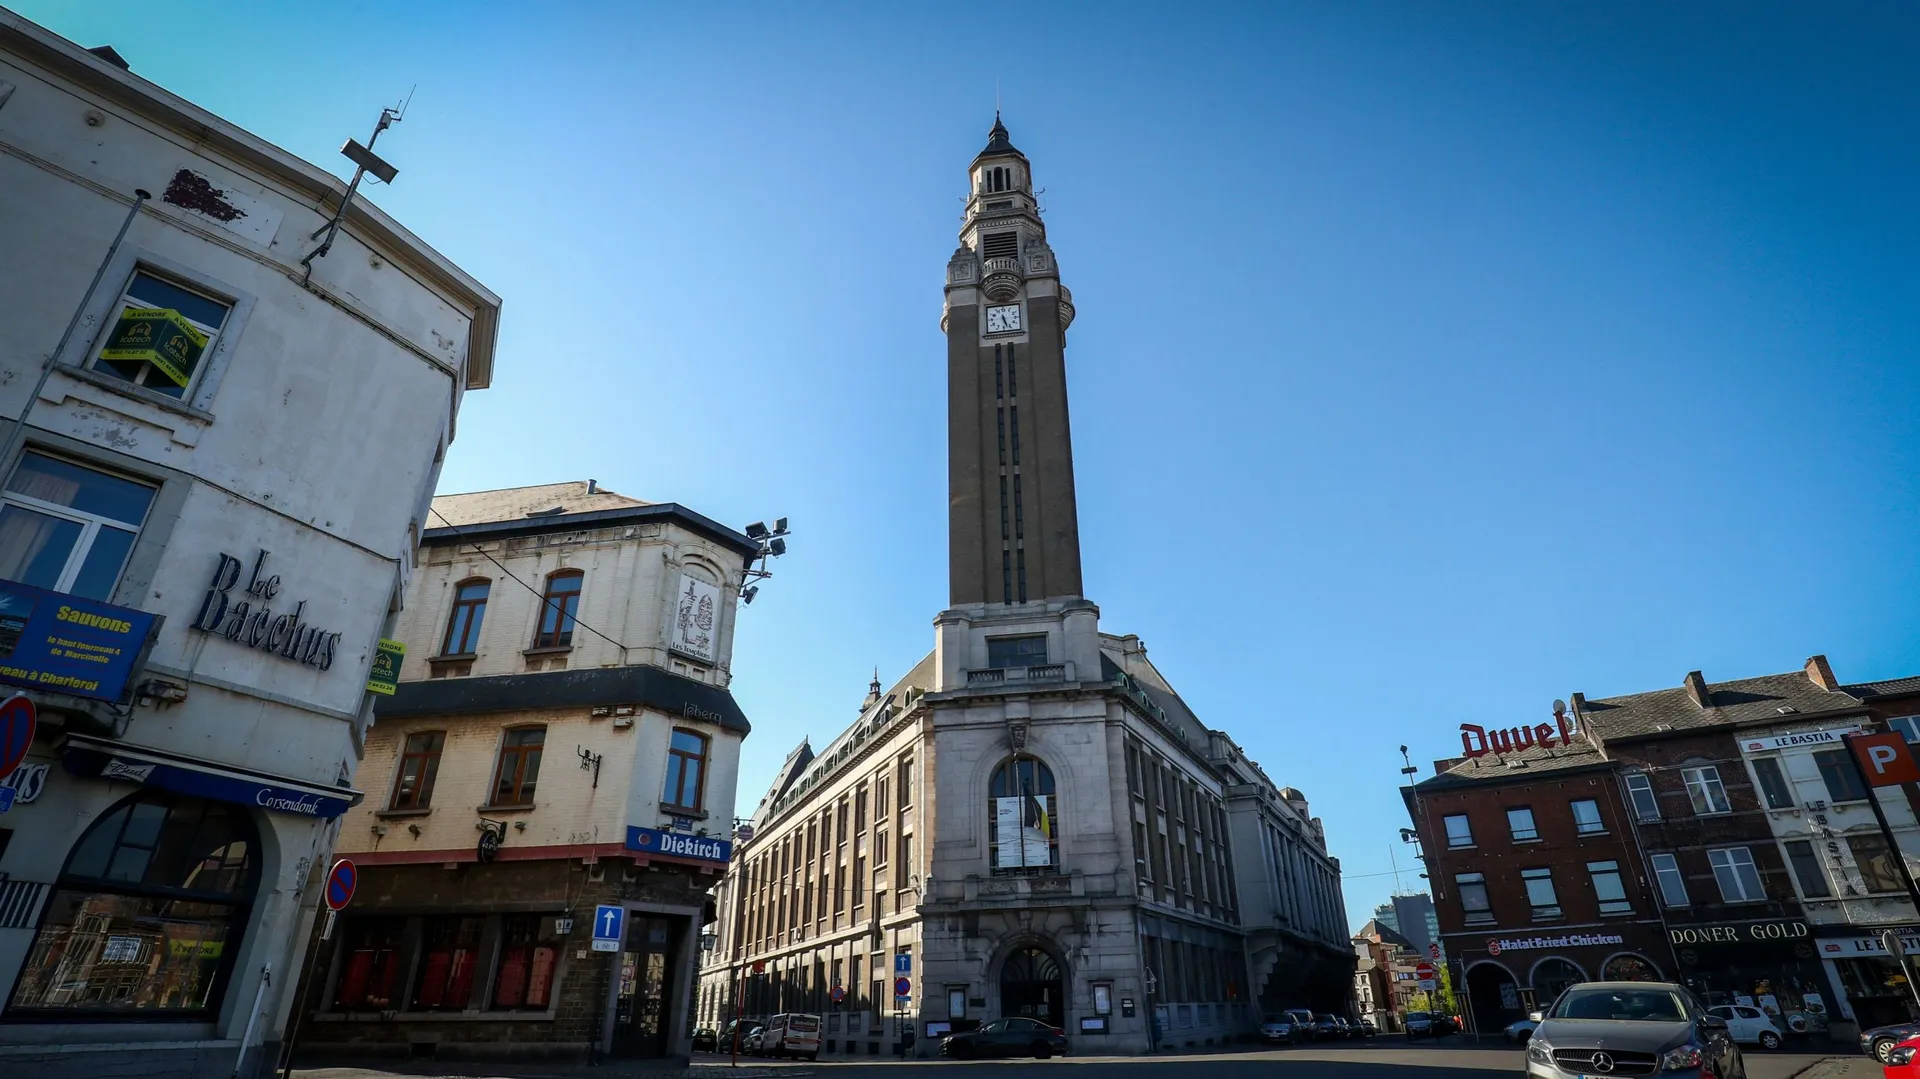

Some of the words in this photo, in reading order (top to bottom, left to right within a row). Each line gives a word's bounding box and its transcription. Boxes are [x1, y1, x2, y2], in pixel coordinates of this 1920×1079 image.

[179, 320, 200, 341] VENDRE
[245, 549, 281, 599] Le
[57, 606, 132, 633] Sauvons
[190, 552, 342, 672] Bacchus
[47, 636, 57, 644] le
[57, 638, 76, 648] haut
[115, 648, 121, 656] 4
[51, 648, 62, 656] de
[64, 650, 110, 664] Marcinelle
[1459, 710, 1571, 759] Duvel
[1775, 737, 1788, 747] LE
[1791, 732, 1833, 745] BASTIA
[110, 762, 148, 778] Bud
[1867, 745, 1897, 774] P
[256, 788, 324, 815] Corsendonk
[1805, 800, 1827, 812] LE
[660, 833, 721, 859] Diekirch
[1570, 933, 1623, 947] Chicken
[1670, 927, 1739, 944] DONER
[1750, 922, 1808, 939] GOLD
[1854, 939, 1874, 951] LE
